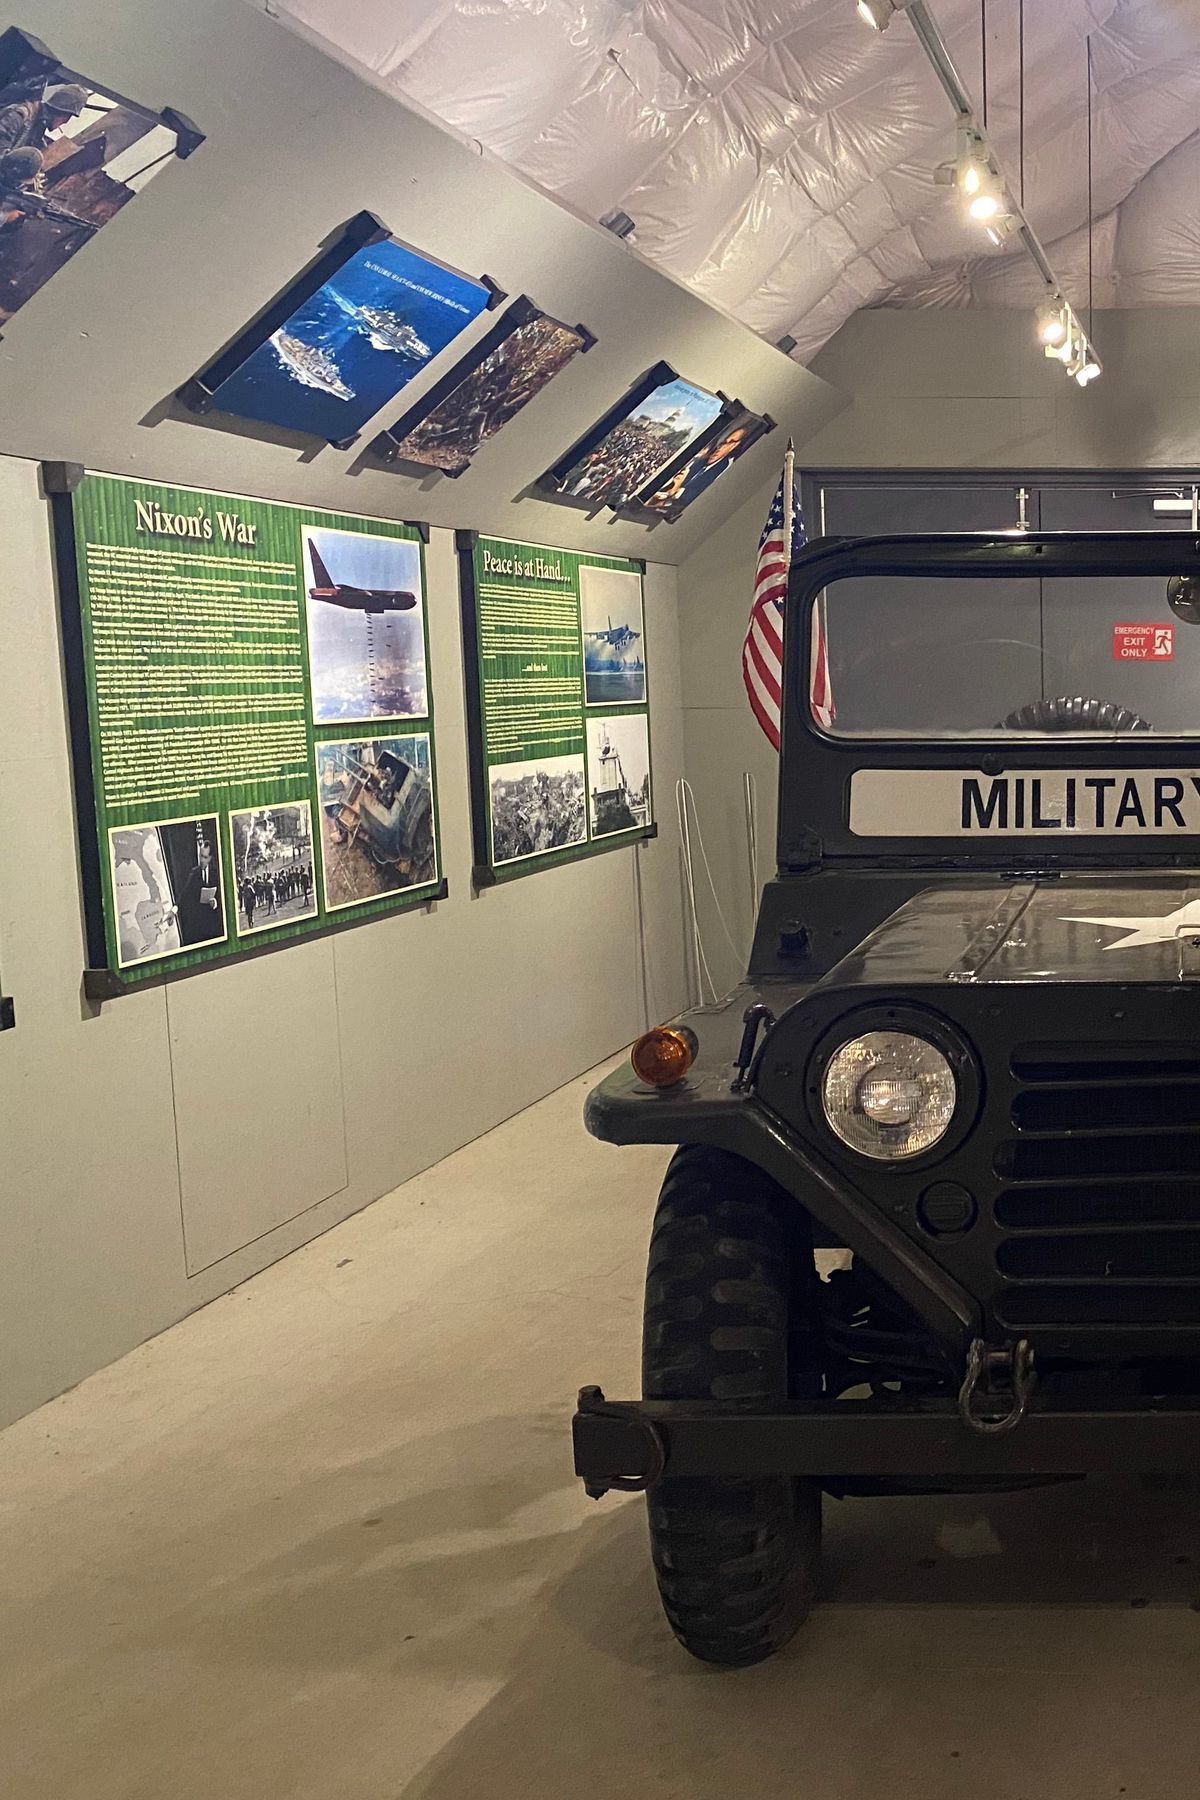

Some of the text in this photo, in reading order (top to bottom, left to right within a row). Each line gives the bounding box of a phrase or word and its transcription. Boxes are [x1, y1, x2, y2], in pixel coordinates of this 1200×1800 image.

[133, 499, 257, 545] Nixon's War
[483, 550, 513, 574] Peace
[514, 555, 523, 576] is
[524, 561, 534, 577] at
[1114, 626, 1155, 634] EMERGENCY
[1123, 637, 1146, 646] EXIT
[1121, 648, 1148, 657] ONLY
